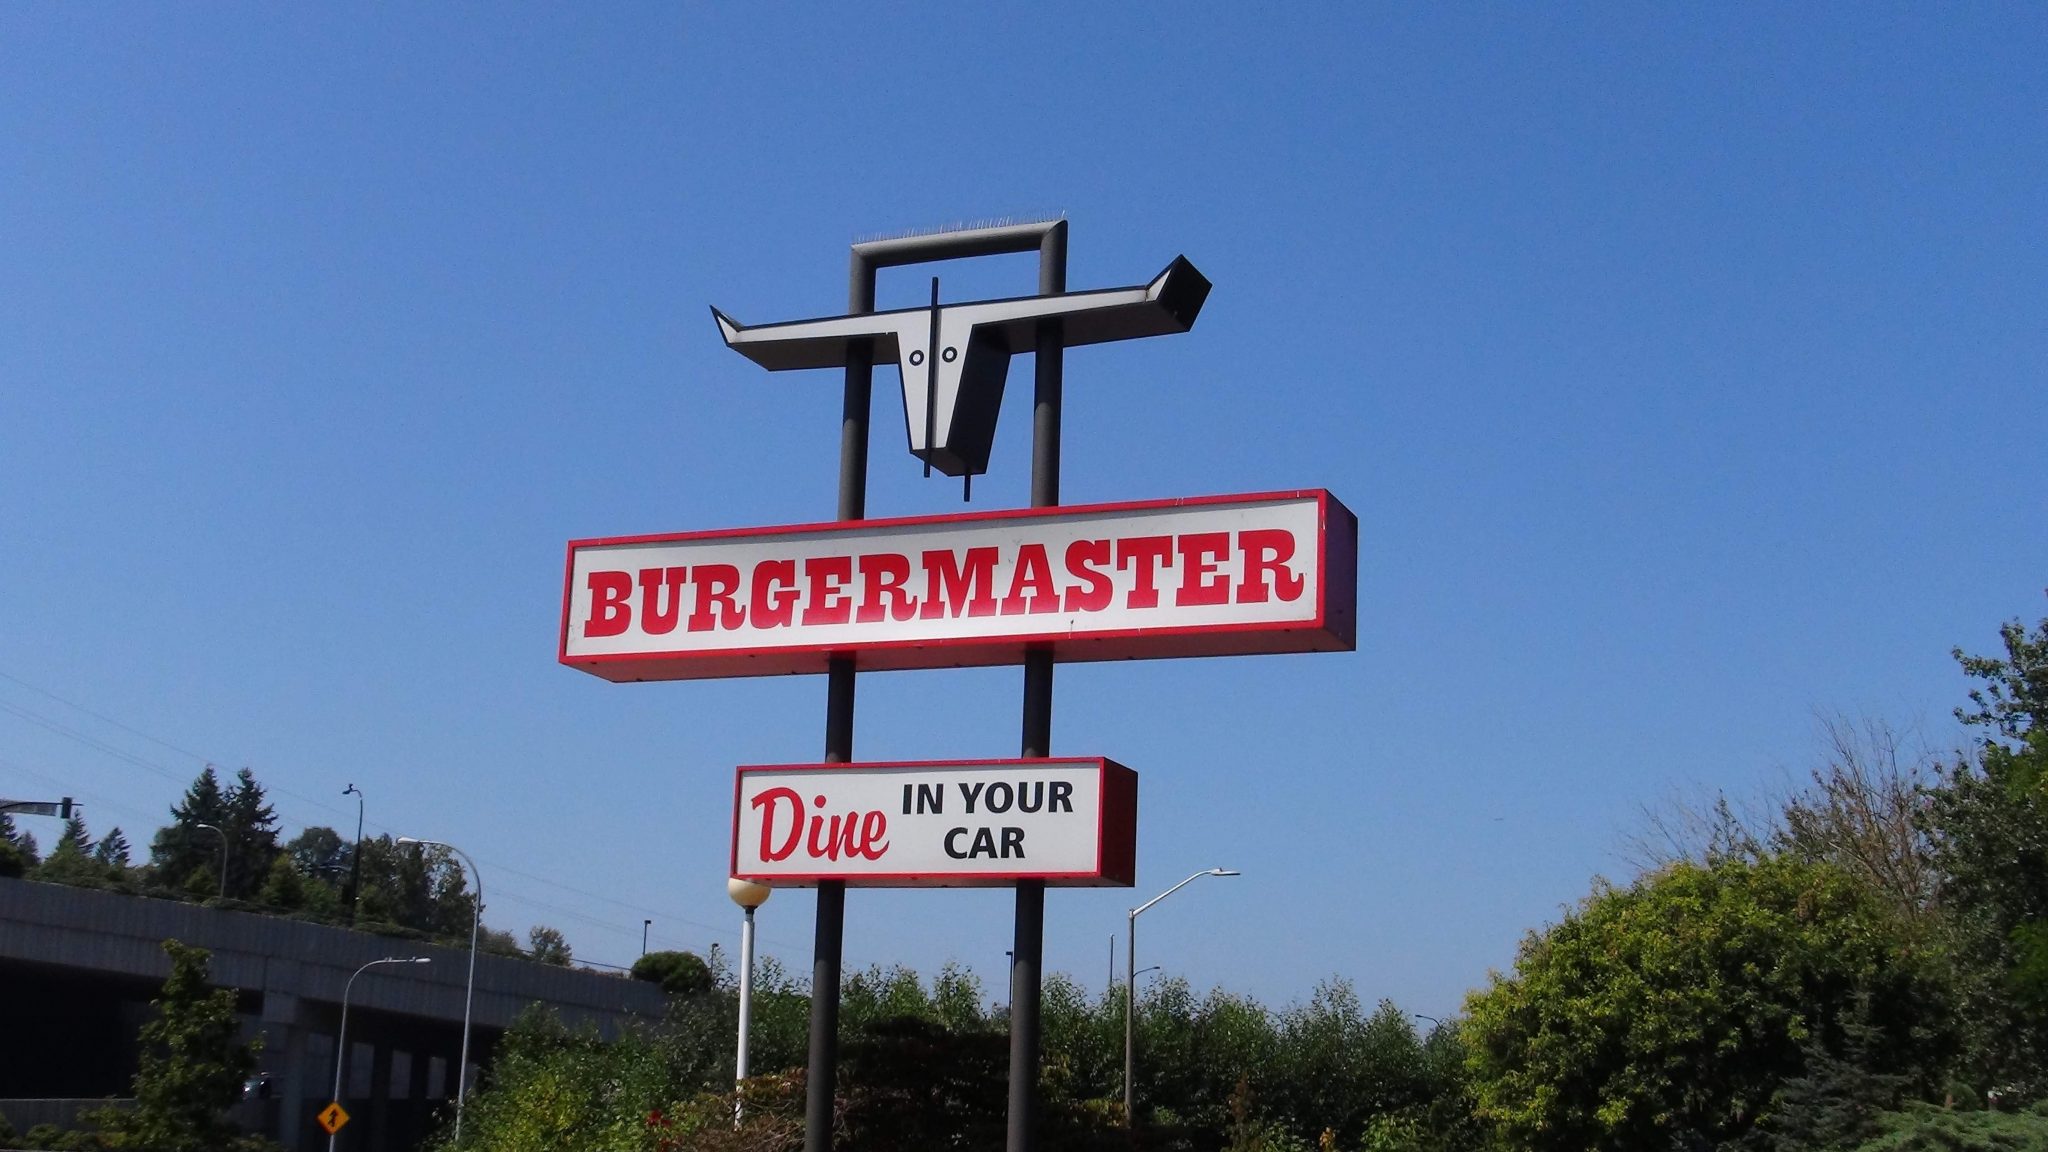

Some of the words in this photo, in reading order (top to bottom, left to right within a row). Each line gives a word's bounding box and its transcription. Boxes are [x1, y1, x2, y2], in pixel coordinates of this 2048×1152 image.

[584, 529, 1304, 638] BURGERMASTER
[752, 787, 890, 862] Dine
[902, 783, 944, 815] IN
[957, 781, 1074, 814] YOUR
[943, 826, 1026, 859] CAR
